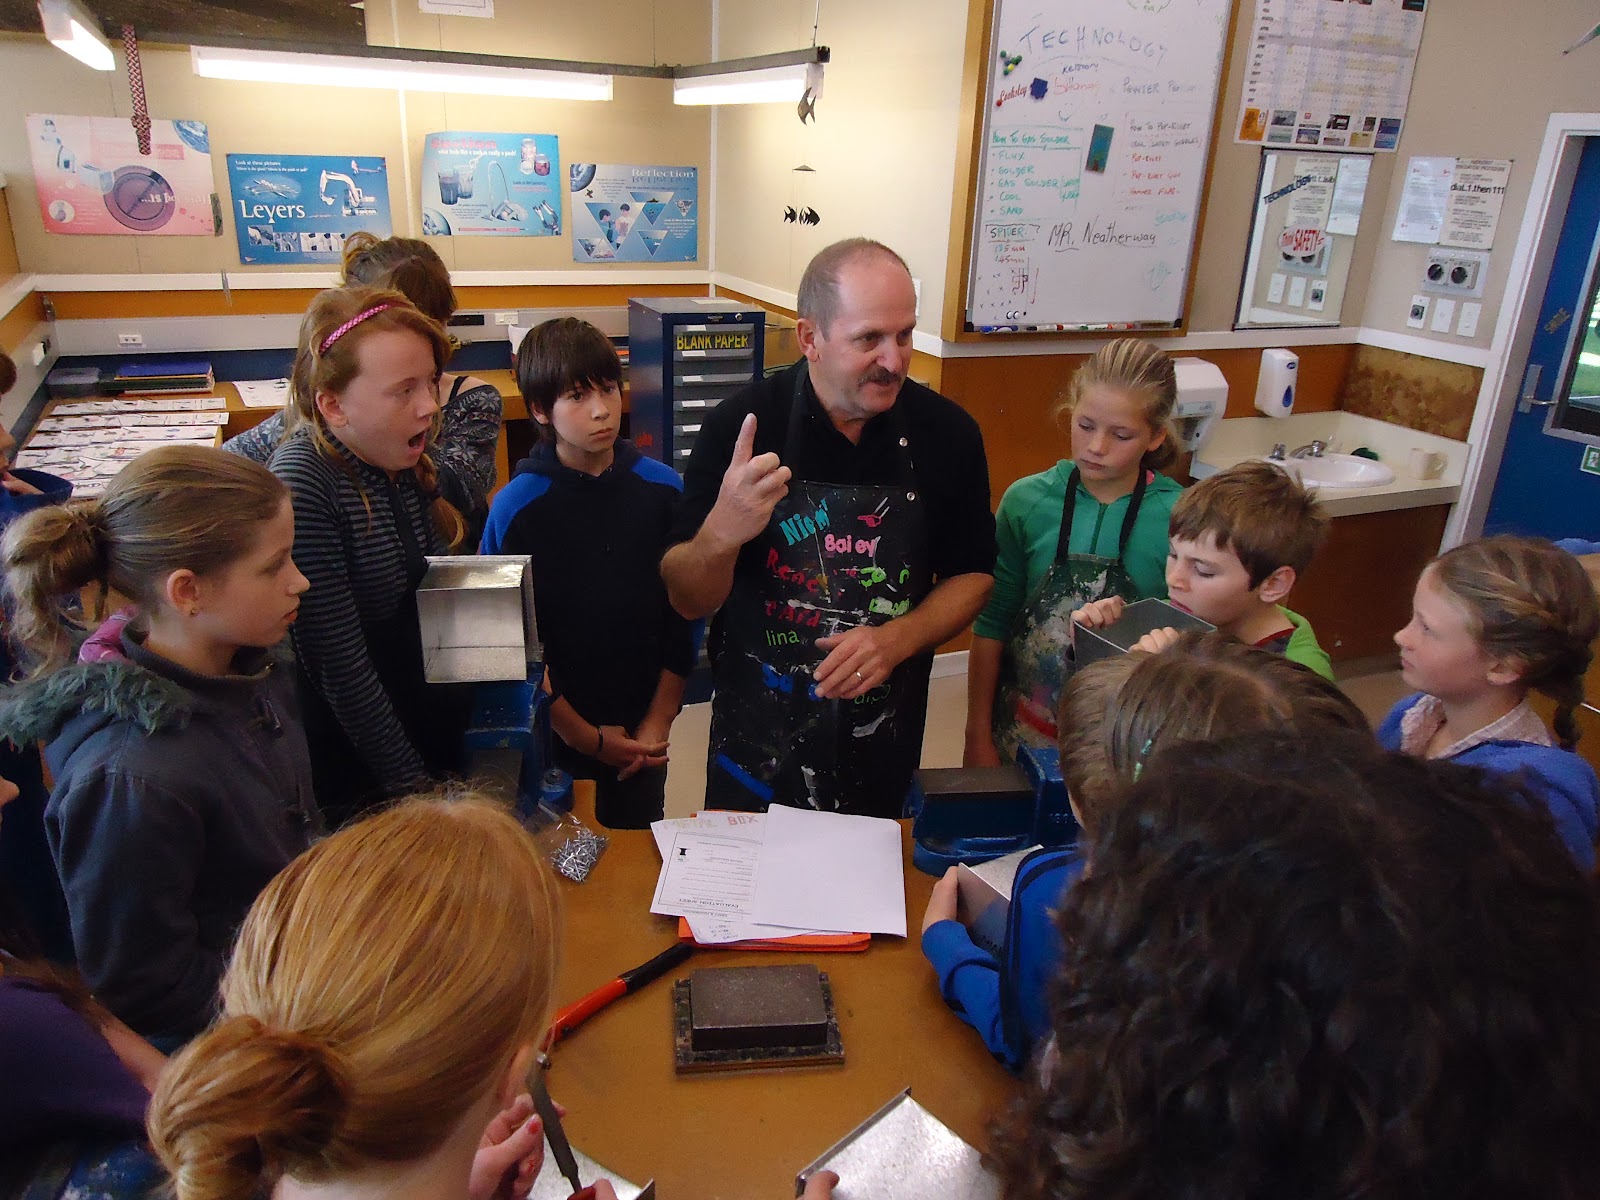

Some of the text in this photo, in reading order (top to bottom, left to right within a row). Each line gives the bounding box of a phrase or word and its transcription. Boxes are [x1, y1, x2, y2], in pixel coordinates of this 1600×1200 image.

[1019, 25, 1168, 65] TECHNOLOGY
[998, 150, 1024, 161] FLUX
[632, 168, 694, 178] Reflection
[998, 164, 1035, 178] SOLDER
[997, 178, 1016, 188] GAS
[1024, 178, 1060, 189] SOLDER
[1263, 173, 1312, 205] TECHNOLOGY
[999, 191, 1022, 202] COOL
[999, 205, 1025, 216] SAND
[990, 226, 1024, 239] SPIDER
[1083, 214, 1157, 245] Neatherway
[1293, 228, 1321, 252] SAFETY
[676, 334, 749, 350] BLANK PAPER
[765, 630, 800, 646] lina
[699, 900, 739, 909] EVALUATION
